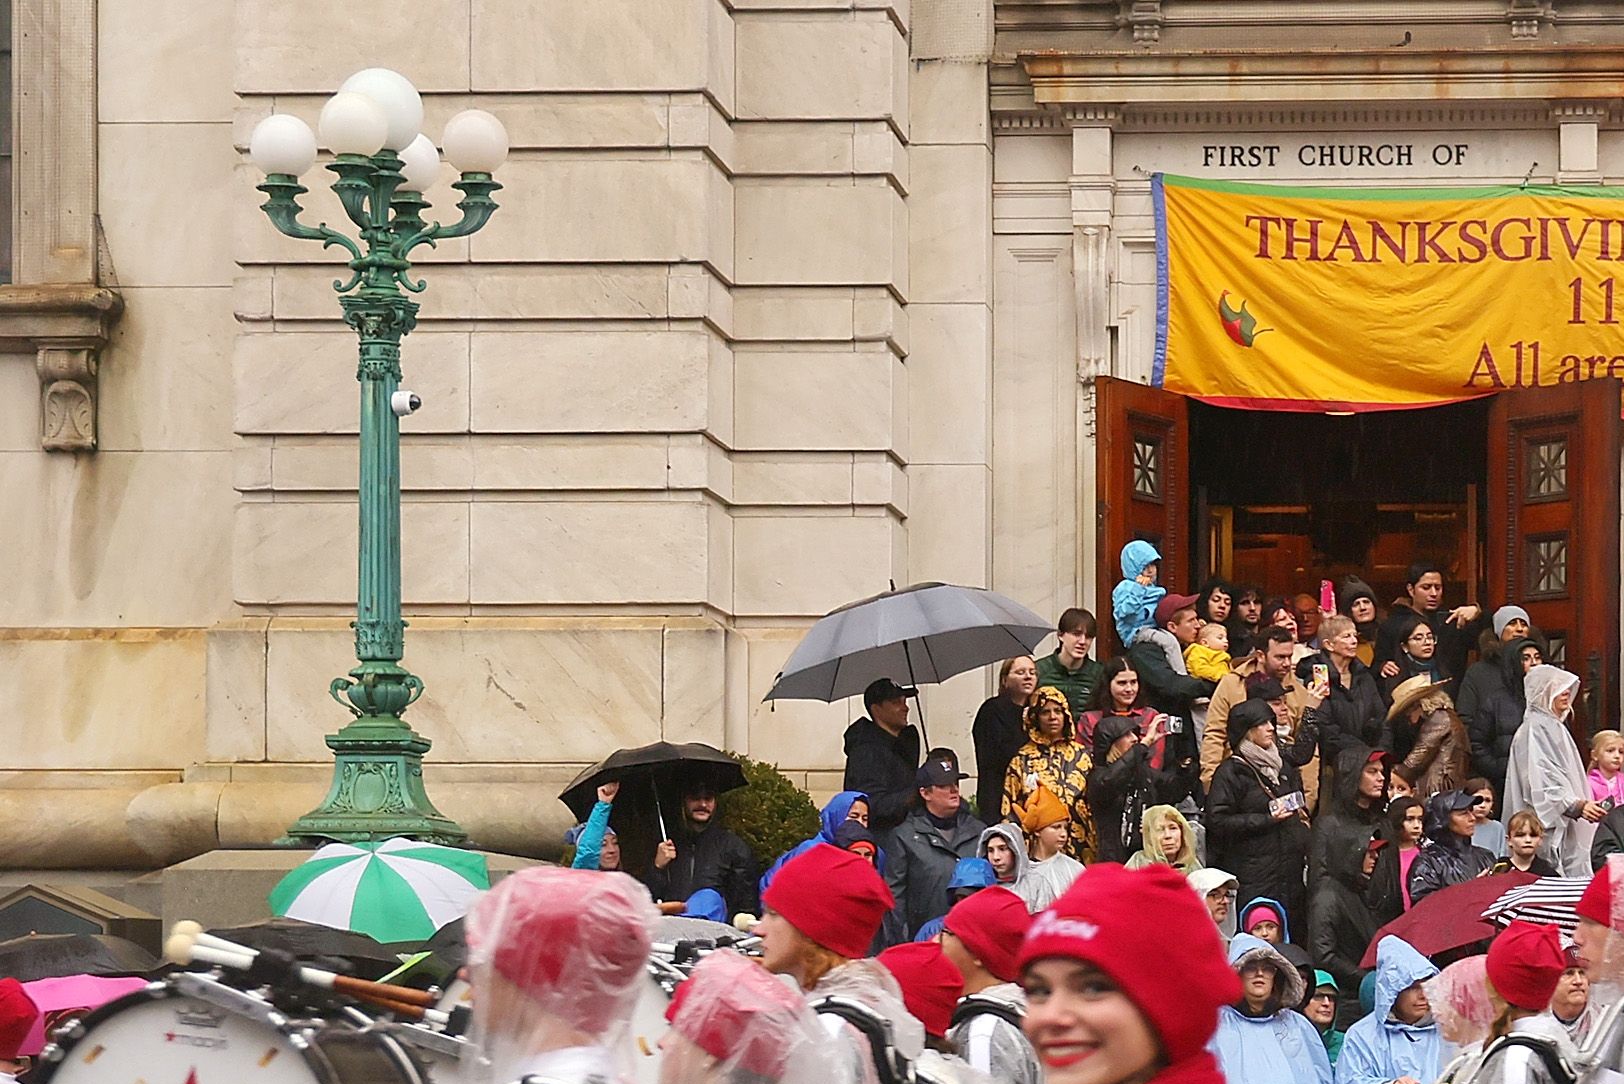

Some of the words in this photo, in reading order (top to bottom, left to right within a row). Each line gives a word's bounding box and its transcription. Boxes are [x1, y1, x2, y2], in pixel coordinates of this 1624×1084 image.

[1202, 145, 1280, 167] FIRST
[1298, 144, 1413, 167] CHURCH
[1432, 144, 1468, 167] OF
[1463, 341, 1541, 388] All
